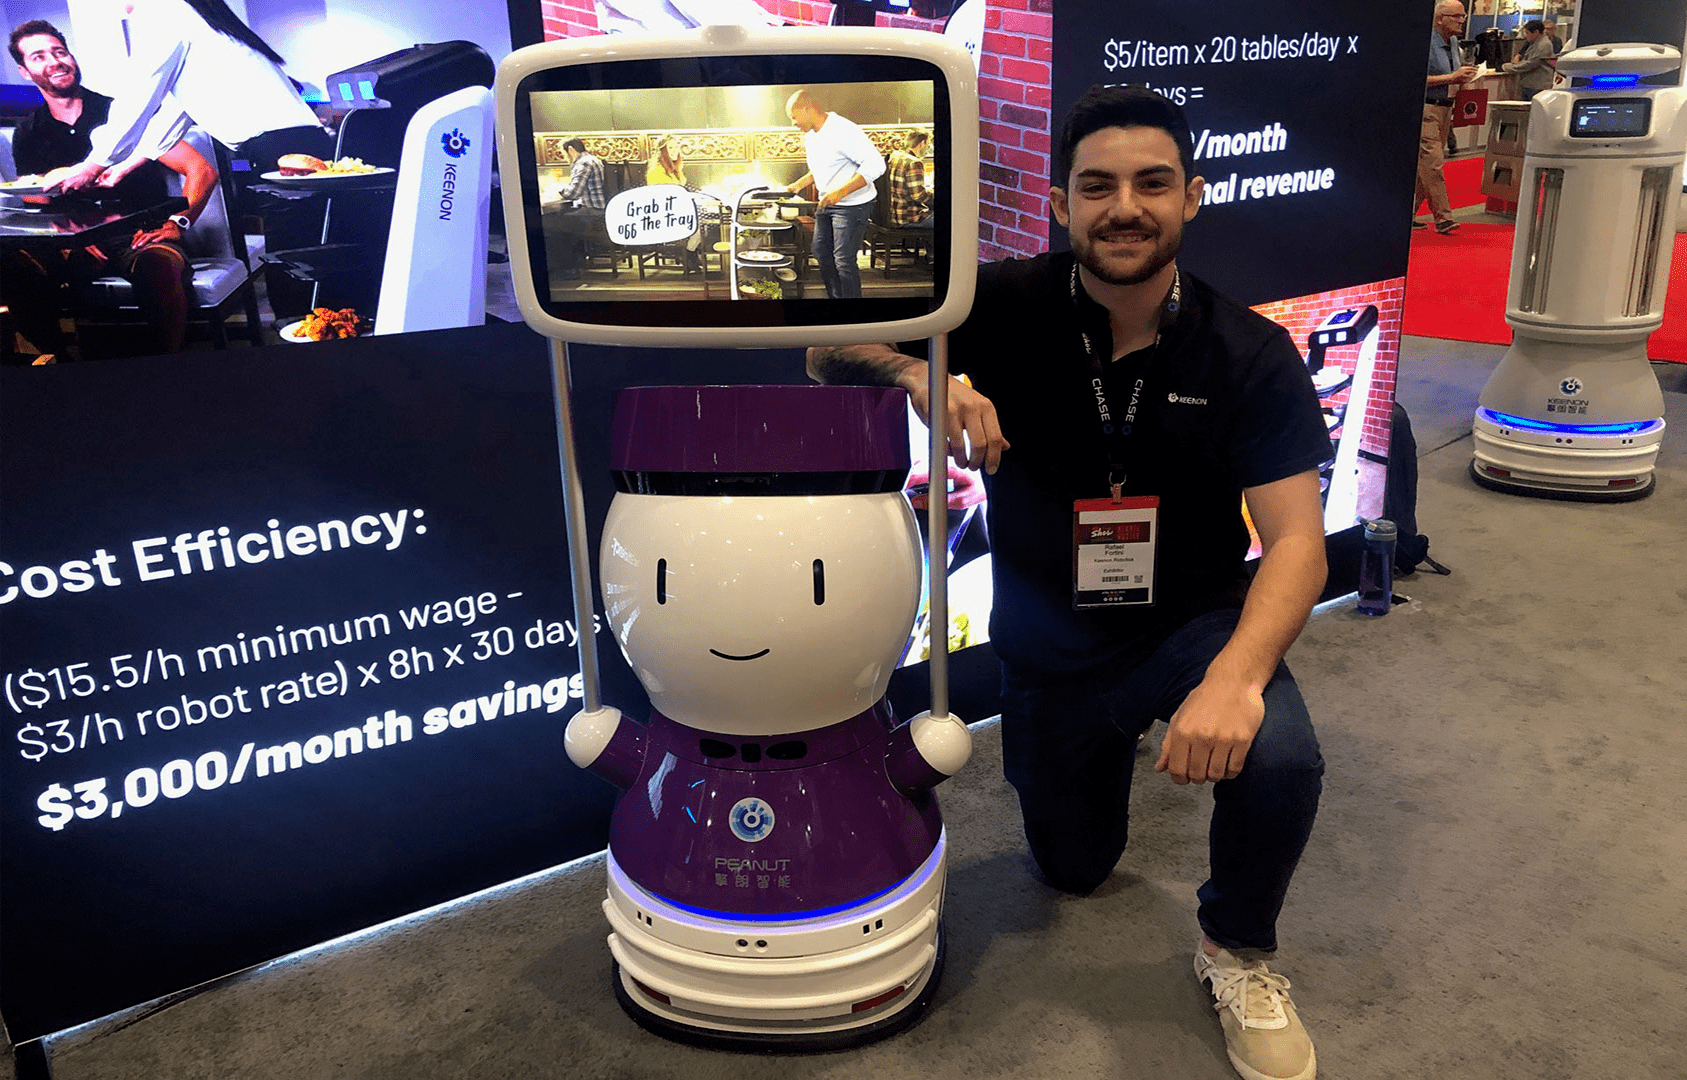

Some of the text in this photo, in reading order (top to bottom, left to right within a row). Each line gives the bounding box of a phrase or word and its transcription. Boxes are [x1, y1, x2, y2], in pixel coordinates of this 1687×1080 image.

[1103, 31, 1359, 72] $5/item x 20 tables/day x
[1190, 122, 1288, 161] /month
[439, 163, 457, 221] KEENON
[1240, 168, 1335, 201] revenue
[627, 195, 677, 217] Grab it
[618, 222, 637, 240] off
[640, 215, 661, 231] the
[1091, 378, 1111, 422] CHASE
[1125, 379, 1144, 422] CHASE
[1178, 396, 1208, 405] KEENON
[132, 508, 428, 582] Efficiency:
[5, 648, 186, 714] ($15.5/h
[197, 613, 391, 673] minimum
[399, 592, 498, 631] wage
[16, 711, 124, 762] $3/h
[137, 685, 252, 736] robot
[260, 660, 349, 709] rate)
[357, 662, 381, 688] x
[389, 647, 435, 680] 8h
[443, 643, 465, 669] x
[471, 626, 515, 661] 30
[36, 672, 585, 832] $3,000/month savings
[715, 857, 791, 872] PEANUT
